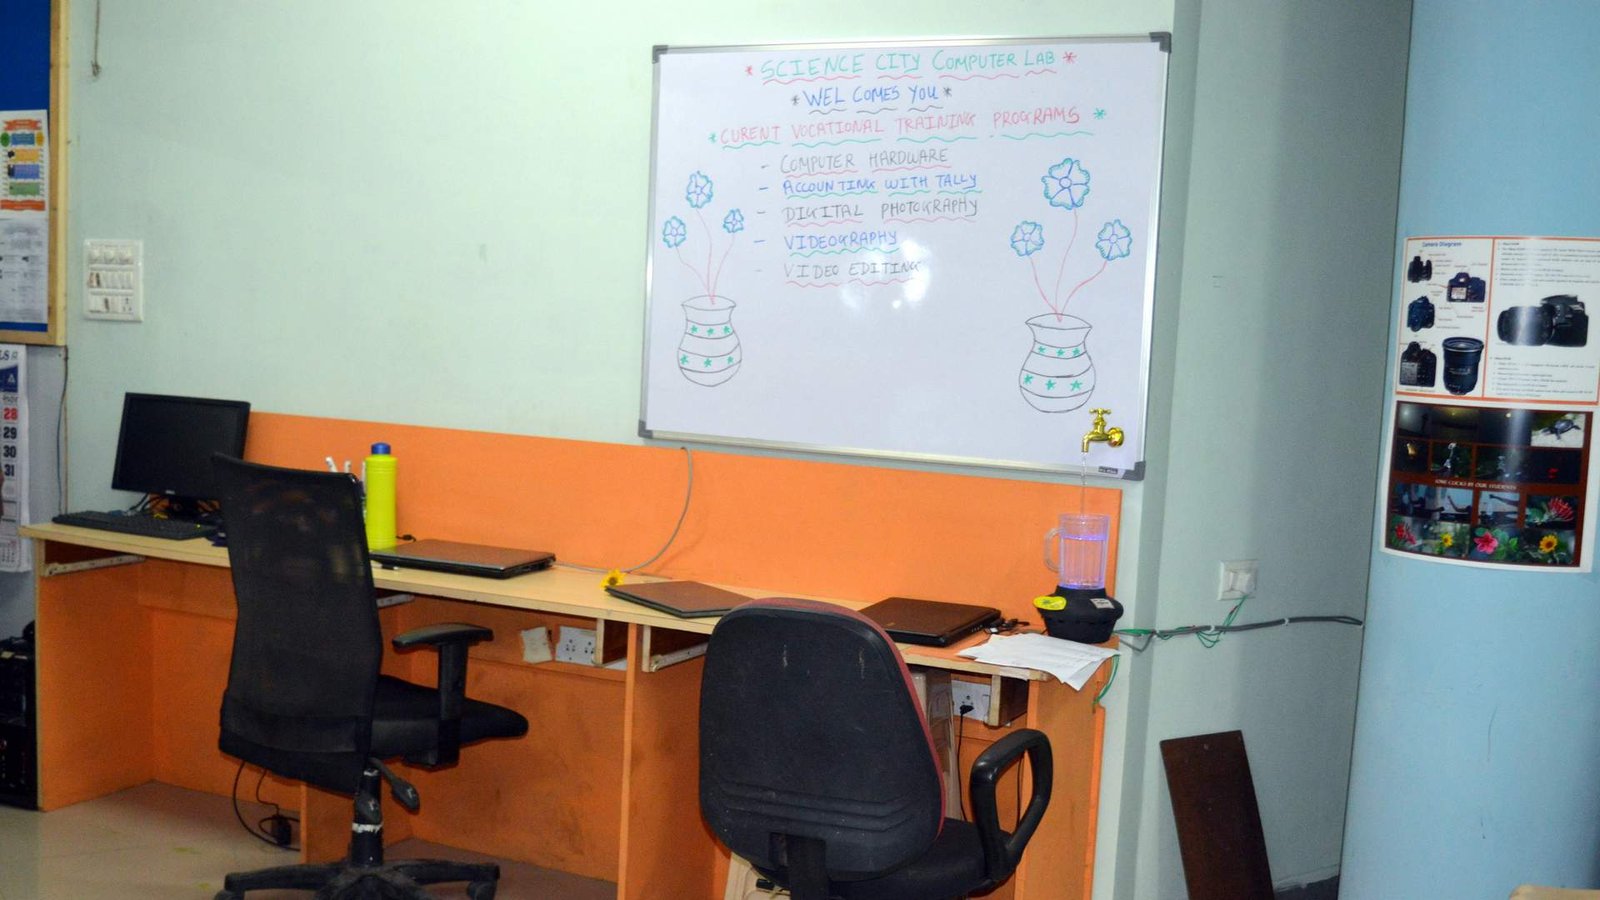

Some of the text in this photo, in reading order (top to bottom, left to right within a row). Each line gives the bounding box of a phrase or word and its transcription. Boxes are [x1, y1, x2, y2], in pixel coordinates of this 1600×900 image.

[760, 50, 1056, 79] SCIENCE CITY COMPUTER LAB
[908, 86, 940, 101] YOU
[720, 107, 1081, 145] CURENT VOCATIONAL TRAINING PROGRAMS
[780, 148, 948, 174] COMPUTER HARDWARE
[783, 174, 978, 195] ACCOUNTING WITH TALLY
[781, 198, 978, 222] DIGITAL PHOTOGRAPHY
[784, 231, 898, 250] VIDEOGRAPHY
[783, 260, 921, 280] VIDEO EDITING
[4, 408, 18, 421] 28
[3, 427, 17, 439] 29
[3, 446, 17, 459] 30
[4, 465, 15, 477] 31
